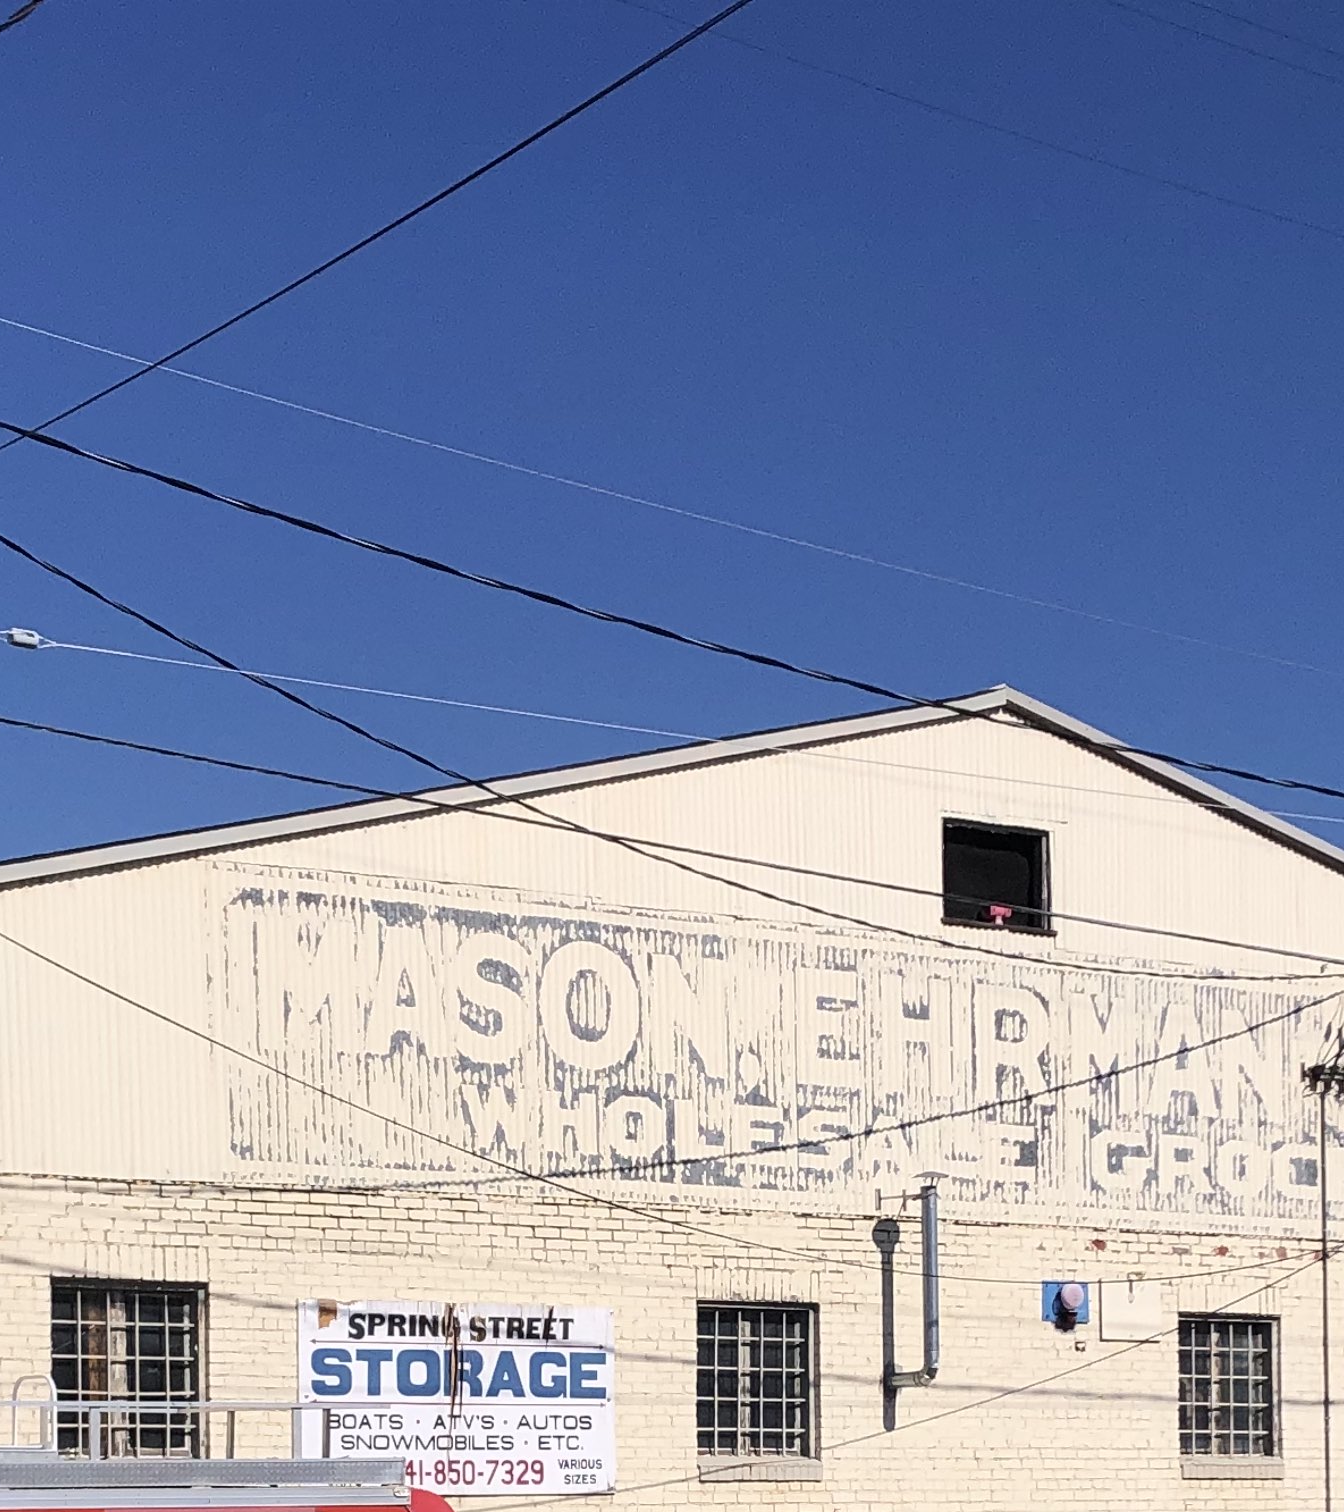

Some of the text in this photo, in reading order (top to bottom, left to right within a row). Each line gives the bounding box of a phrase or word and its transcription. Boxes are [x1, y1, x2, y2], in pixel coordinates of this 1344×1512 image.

[796, 964, 1286, 1127] EHRMAN
[459, 1084, 1036, 1182] WHOLESALE
[348, 1312, 574, 1342] SPRING STREET
[311, 1348, 607, 1399] STORAGE
[329, 1413, 592, 1430] BOATS ATV'S AUTOS
[341, 1435, 584, 1451] SNOWMOBILES ETC.
[557, 1459, 603, 1470] VARIOUS
[564, 1474, 597, 1485] SIZES
